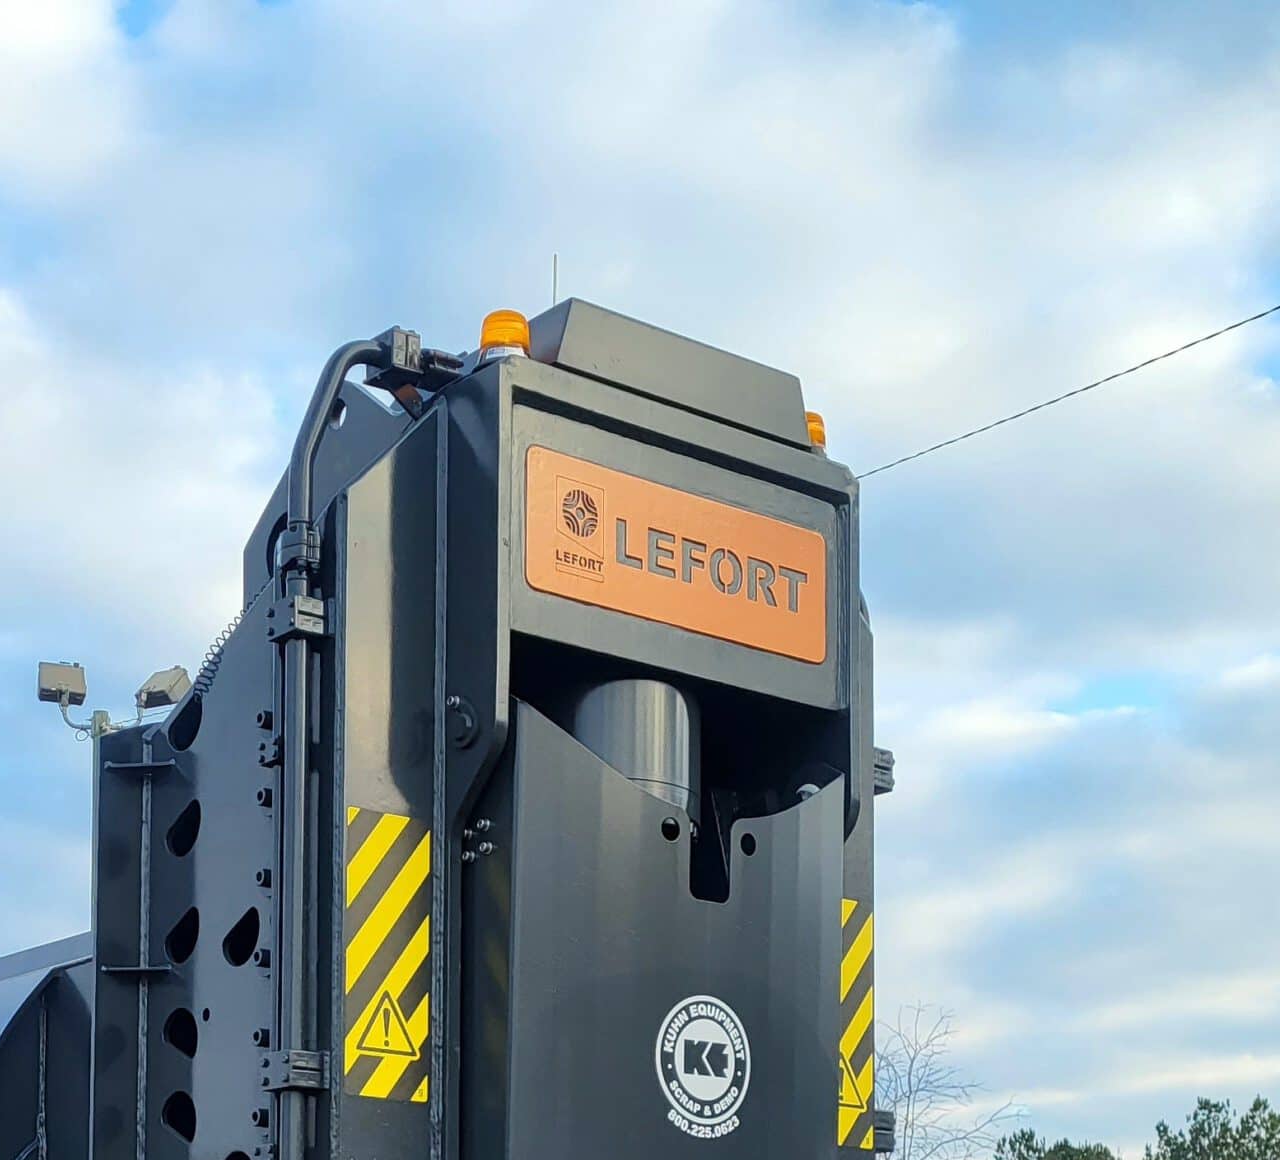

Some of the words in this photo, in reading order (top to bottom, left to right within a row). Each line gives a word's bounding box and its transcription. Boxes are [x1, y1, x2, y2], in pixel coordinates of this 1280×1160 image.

[555, 548, 604, 572] LEFORT
[616, 517, 807, 613] LEFORT
[663, 1010, 690, 1053] KUHN
[689, 1003, 744, 1061] EQUIPMENT
[670, 1080, 701, 1115] SCRAP
[703, 1105, 712, 1116] &
[713, 1086, 739, 1115] DEMO
[667, 1108, 740, 1139] 800.225.0623
